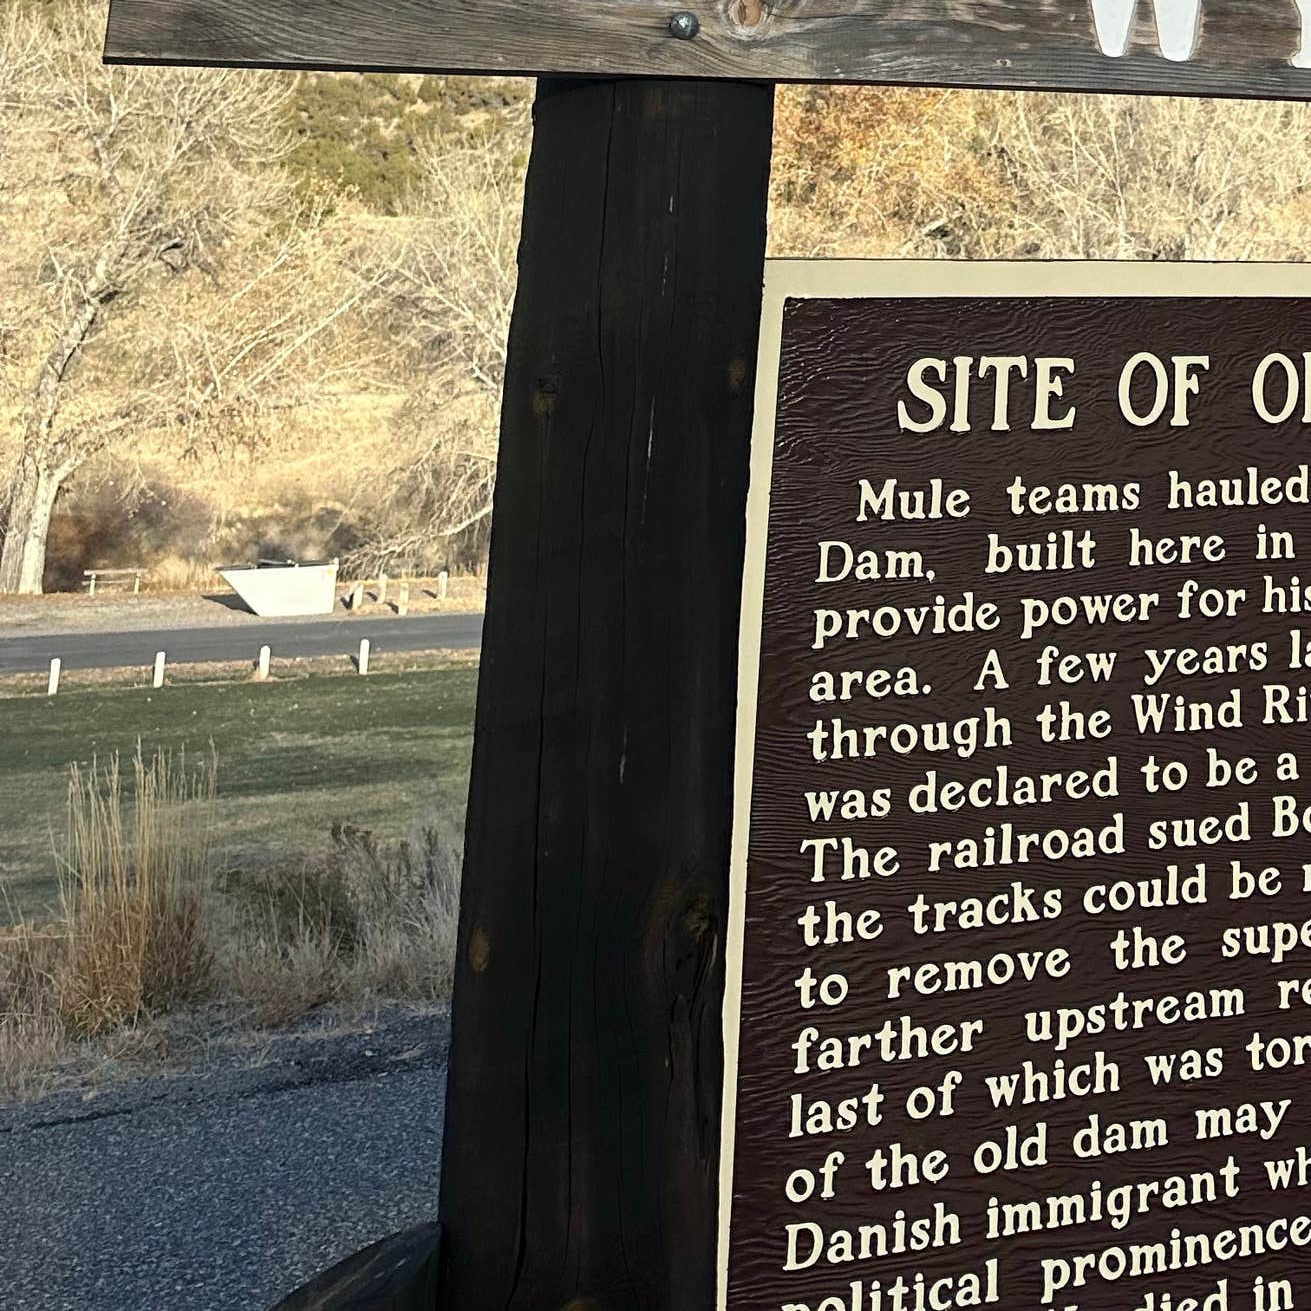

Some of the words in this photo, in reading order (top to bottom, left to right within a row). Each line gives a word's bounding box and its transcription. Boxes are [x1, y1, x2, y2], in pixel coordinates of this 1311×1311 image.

[897, 354, 1076, 433] SITE
[1118, 351, 1210, 427] OF
[856, 478, 971, 522] Mule
[1006, 475, 1140, 516] teams
[1167, 464, 1310, 509] hauled
[814, 540, 936, 584] Dam,
[984, 530, 1097, 574] built
[1128, 527, 1226, 566] here
[1255, 523, 1296, 560] in
[811, 591, 1001, 650] provide
[1020, 592, 1160, 640] power
[1176, 579, 1246, 619] for
[809, 666, 932, 702] area.
[973, 648, 1010, 691] A
[1036, 645, 1117, 686] few
[1143, 641, 1268, 686] years
[806, 707, 1013, 762] through
[1035, 700, 1112, 743] the
[1130, 688, 1244, 734] Wind
[804, 788, 891, 822] was
[908, 755, 1120, 813] declared
[1140, 755, 1188, 793] to
[1205, 747, 1258, 788] be
[799, 836, 900, 883] The
[927, 812, 1126, 872] railroad
[1148, 801, 1252, 850] sued
[797, 900, 884, 947] the
[907, 881, 1062, 935] tracks
[1083, 863, 1208, 914] could
[1228, 860, 1282, 900] be
[794, 967, 849, 1009] to
[887, 948, 1071, 999] remove
[1109, 926, 1187, 970] the
[791, 1015, 984, 1074] farther
[1024, 988, 1245, 1051] upstream
[788, 1083, 885, 1138] last
[906, 1070, 963, 1120] of
[984, 1051, 1121, 1108] which
[1143, 1047, 1223, 1086] was
[785, 1151, 845, 1203] of
[864, 1142, 950, 1191] the
[973, 1122, 1048, 1174] old
[1072, 1113, 1169, 1158] dam
[1195, 1099, 1292, 1140] may
[782, 1202, 962, 1271] Danish
[985, 1155, 1240, 1239] immigrant
